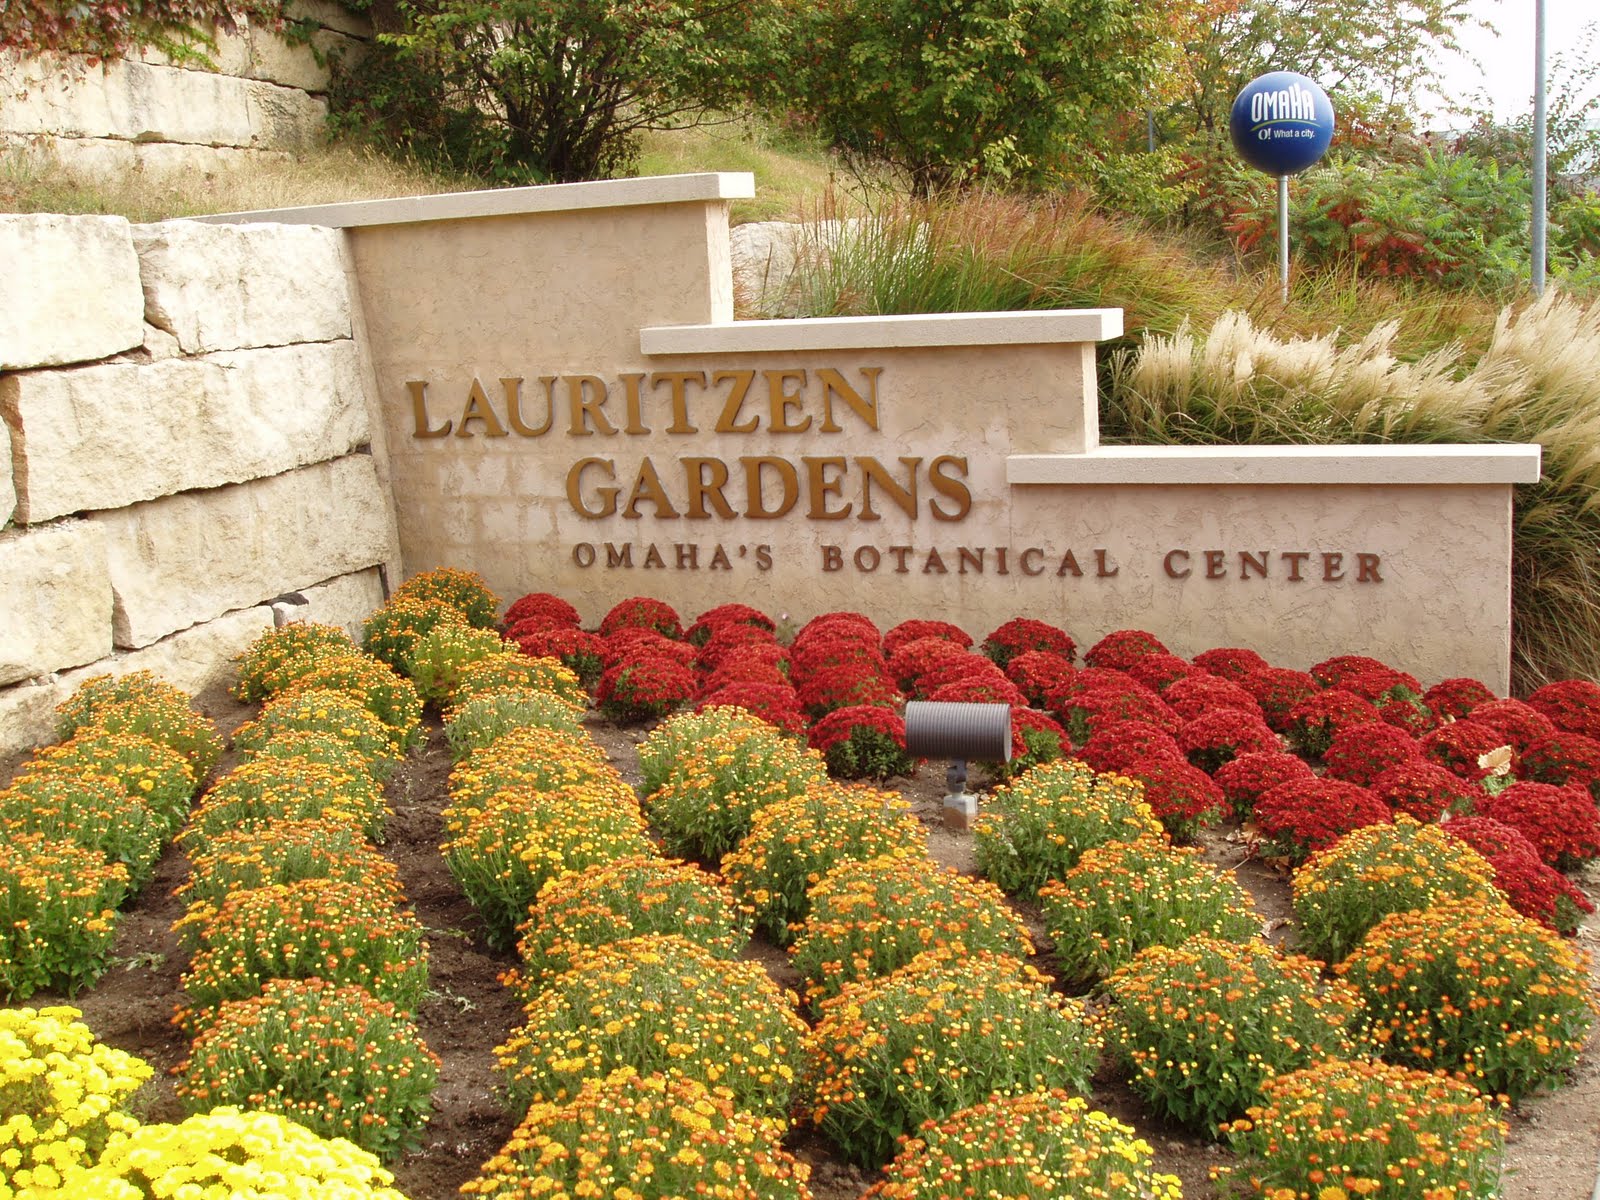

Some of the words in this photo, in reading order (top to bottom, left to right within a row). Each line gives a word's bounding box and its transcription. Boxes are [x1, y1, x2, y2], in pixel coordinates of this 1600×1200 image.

[1251, 82, 1315, 123] OMAHA
[1258, 128, 1271, 140] O!
[1274, 130, 1293, 138] What
[1301, 128, 1315, 139] city.
[406, 367, 885, 438] LAURITZEN
[566, 455, 973, 522] GARDENS
[572, 541, 773, 571] OMAHA'S
[820, 544, 1119, 578] BOTANICAL
[1163, 549, 1385, 583] CENTER
